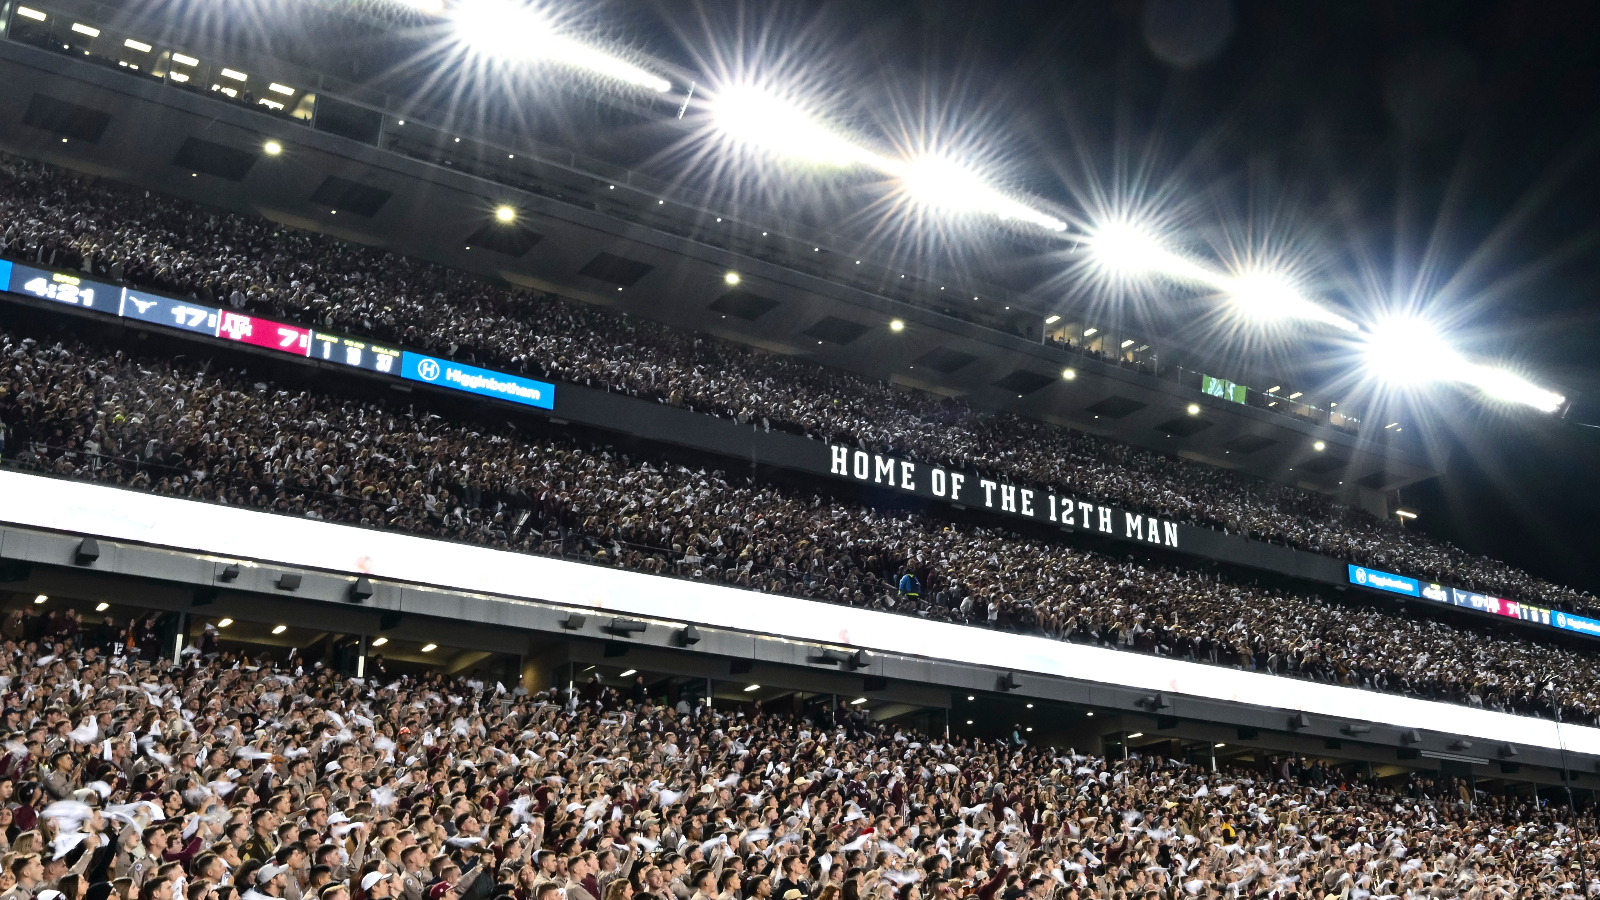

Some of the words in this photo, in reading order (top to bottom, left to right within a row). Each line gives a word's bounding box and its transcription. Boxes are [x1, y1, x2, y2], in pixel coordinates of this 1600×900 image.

[24, 277, 94, 307] 4:21
[171, 305, 208, 327] 17
[278, 328, 299, 347] 7
[323, 341, 331, 359] 1
[446, 367, 541, 400] Higginbotham
[830, 445, 915, 491] HOME
[931, 468, 965, 501] OF
[980, 479, 1035, 518] THE
[1048, 494, 1113, 534] 12TH
[1125, 512, 1179, 548] MAN
